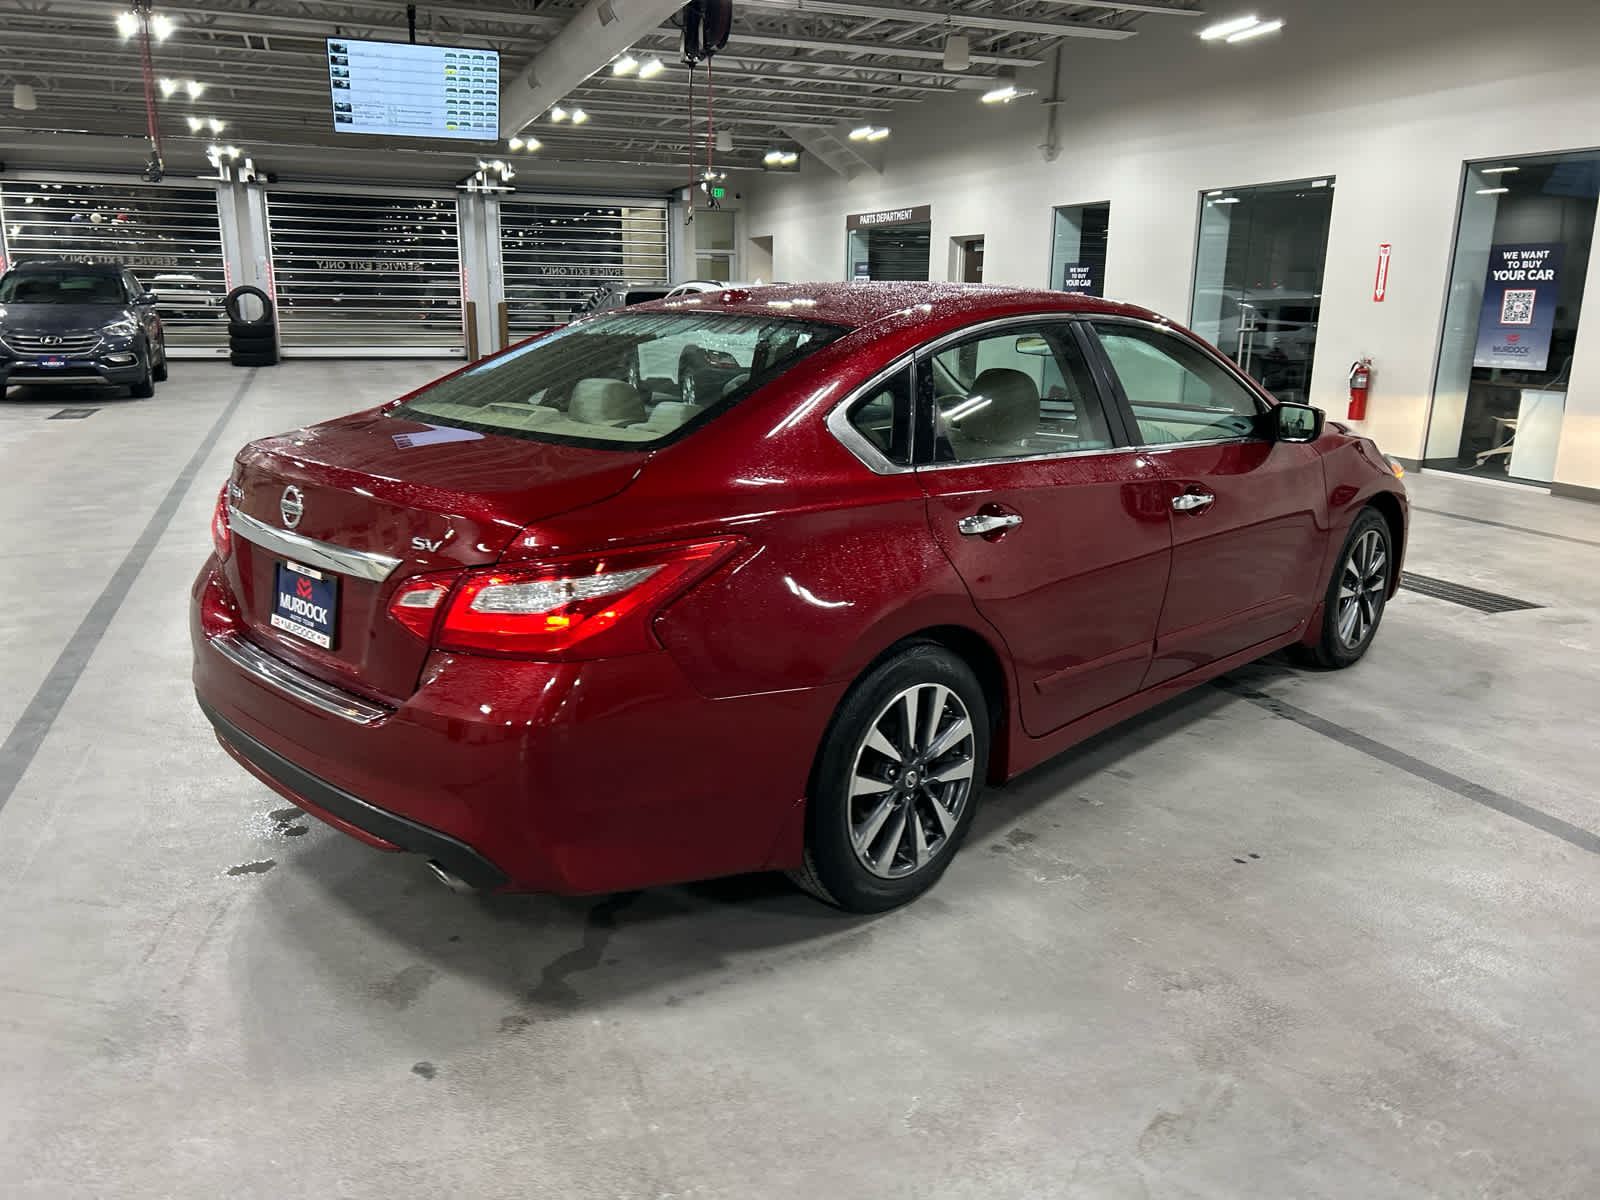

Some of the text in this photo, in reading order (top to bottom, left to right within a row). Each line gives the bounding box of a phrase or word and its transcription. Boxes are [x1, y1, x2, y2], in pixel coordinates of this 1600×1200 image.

[859, 209, 913, 225] PARTS DEPARTMENT
[1503, 250, 1550, 260] WE WANT
[1507, 260, 1542, 269] TO BUY
[1493, 269, 1555, 281] YOUR CAR
[1065, 279, 1092, 287] YOUR CAR
[411, 536, 443, 552] SV
[279, 591, 328, 625] MURDOCK
